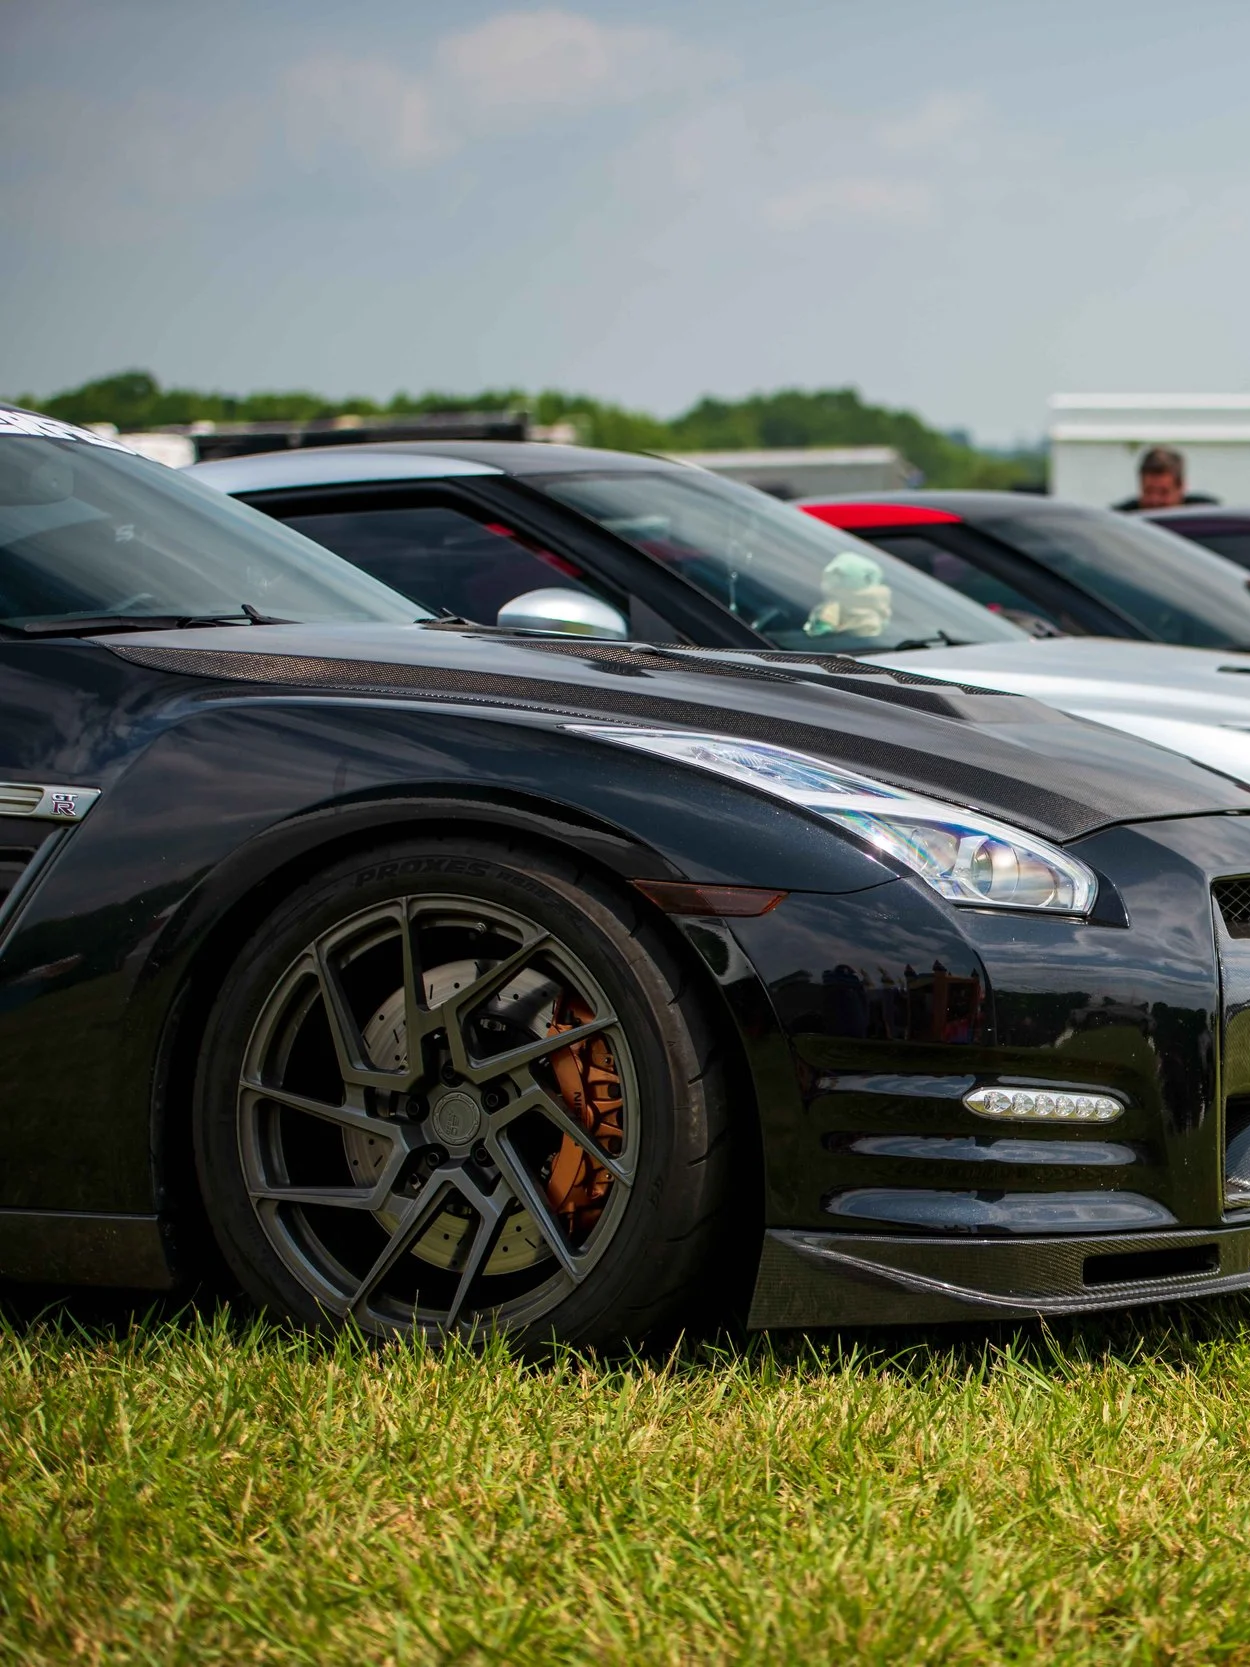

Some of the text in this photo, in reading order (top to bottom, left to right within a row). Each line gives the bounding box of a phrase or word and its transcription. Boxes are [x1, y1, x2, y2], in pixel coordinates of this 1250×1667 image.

[52, 793, 78, 801] GT
[51, 801, 76, 816] R
[353, 858, 491, 889] PROXES
